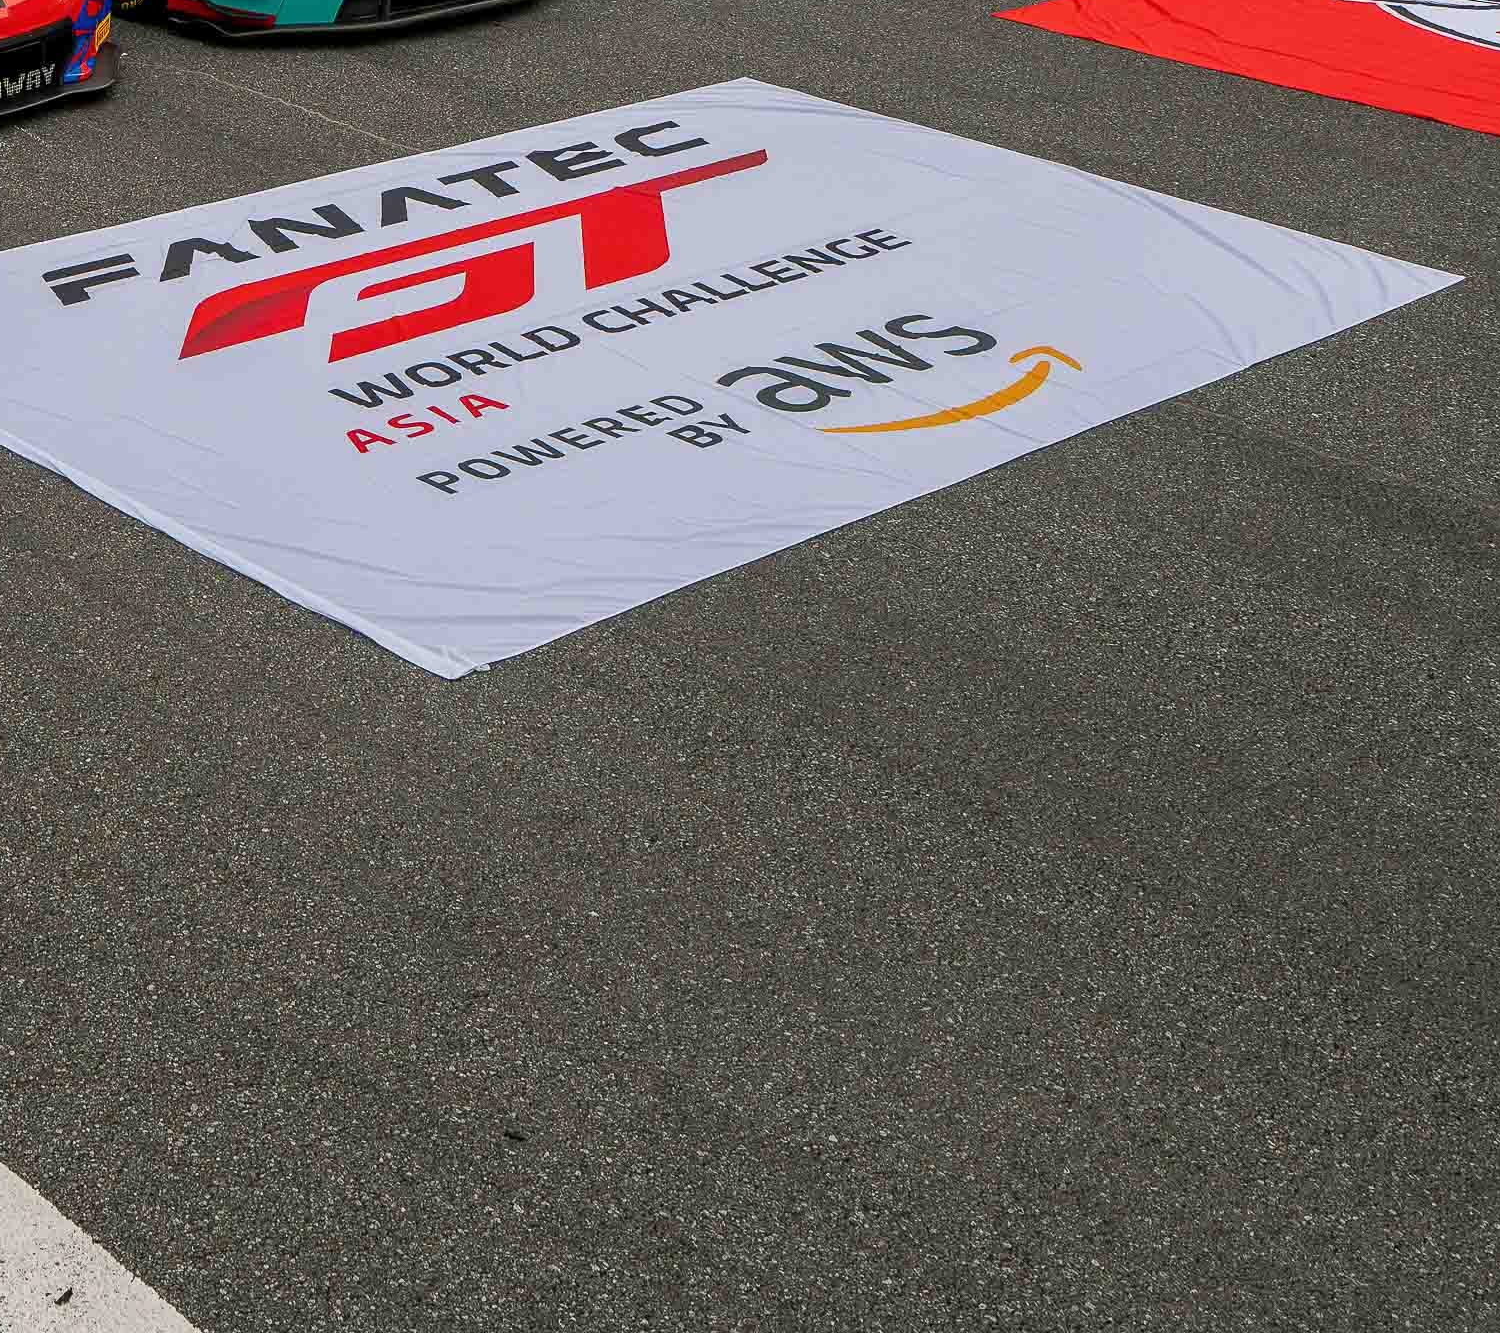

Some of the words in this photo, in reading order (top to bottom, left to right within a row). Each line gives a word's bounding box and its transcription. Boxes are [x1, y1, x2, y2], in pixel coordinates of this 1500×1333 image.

[42, 121, 710, 306] FANATEC
[179, 148, 768, 364] GT
[329, 323, 579, 411] WORLD
[583, 228, 913, 333] CHALLENGE
[671, 412, 752, 453] BY
[715, 310, 998, 414] aws
[348, 394, 510, 454] ASIA
[417, 392, 706, 496] POWERED
